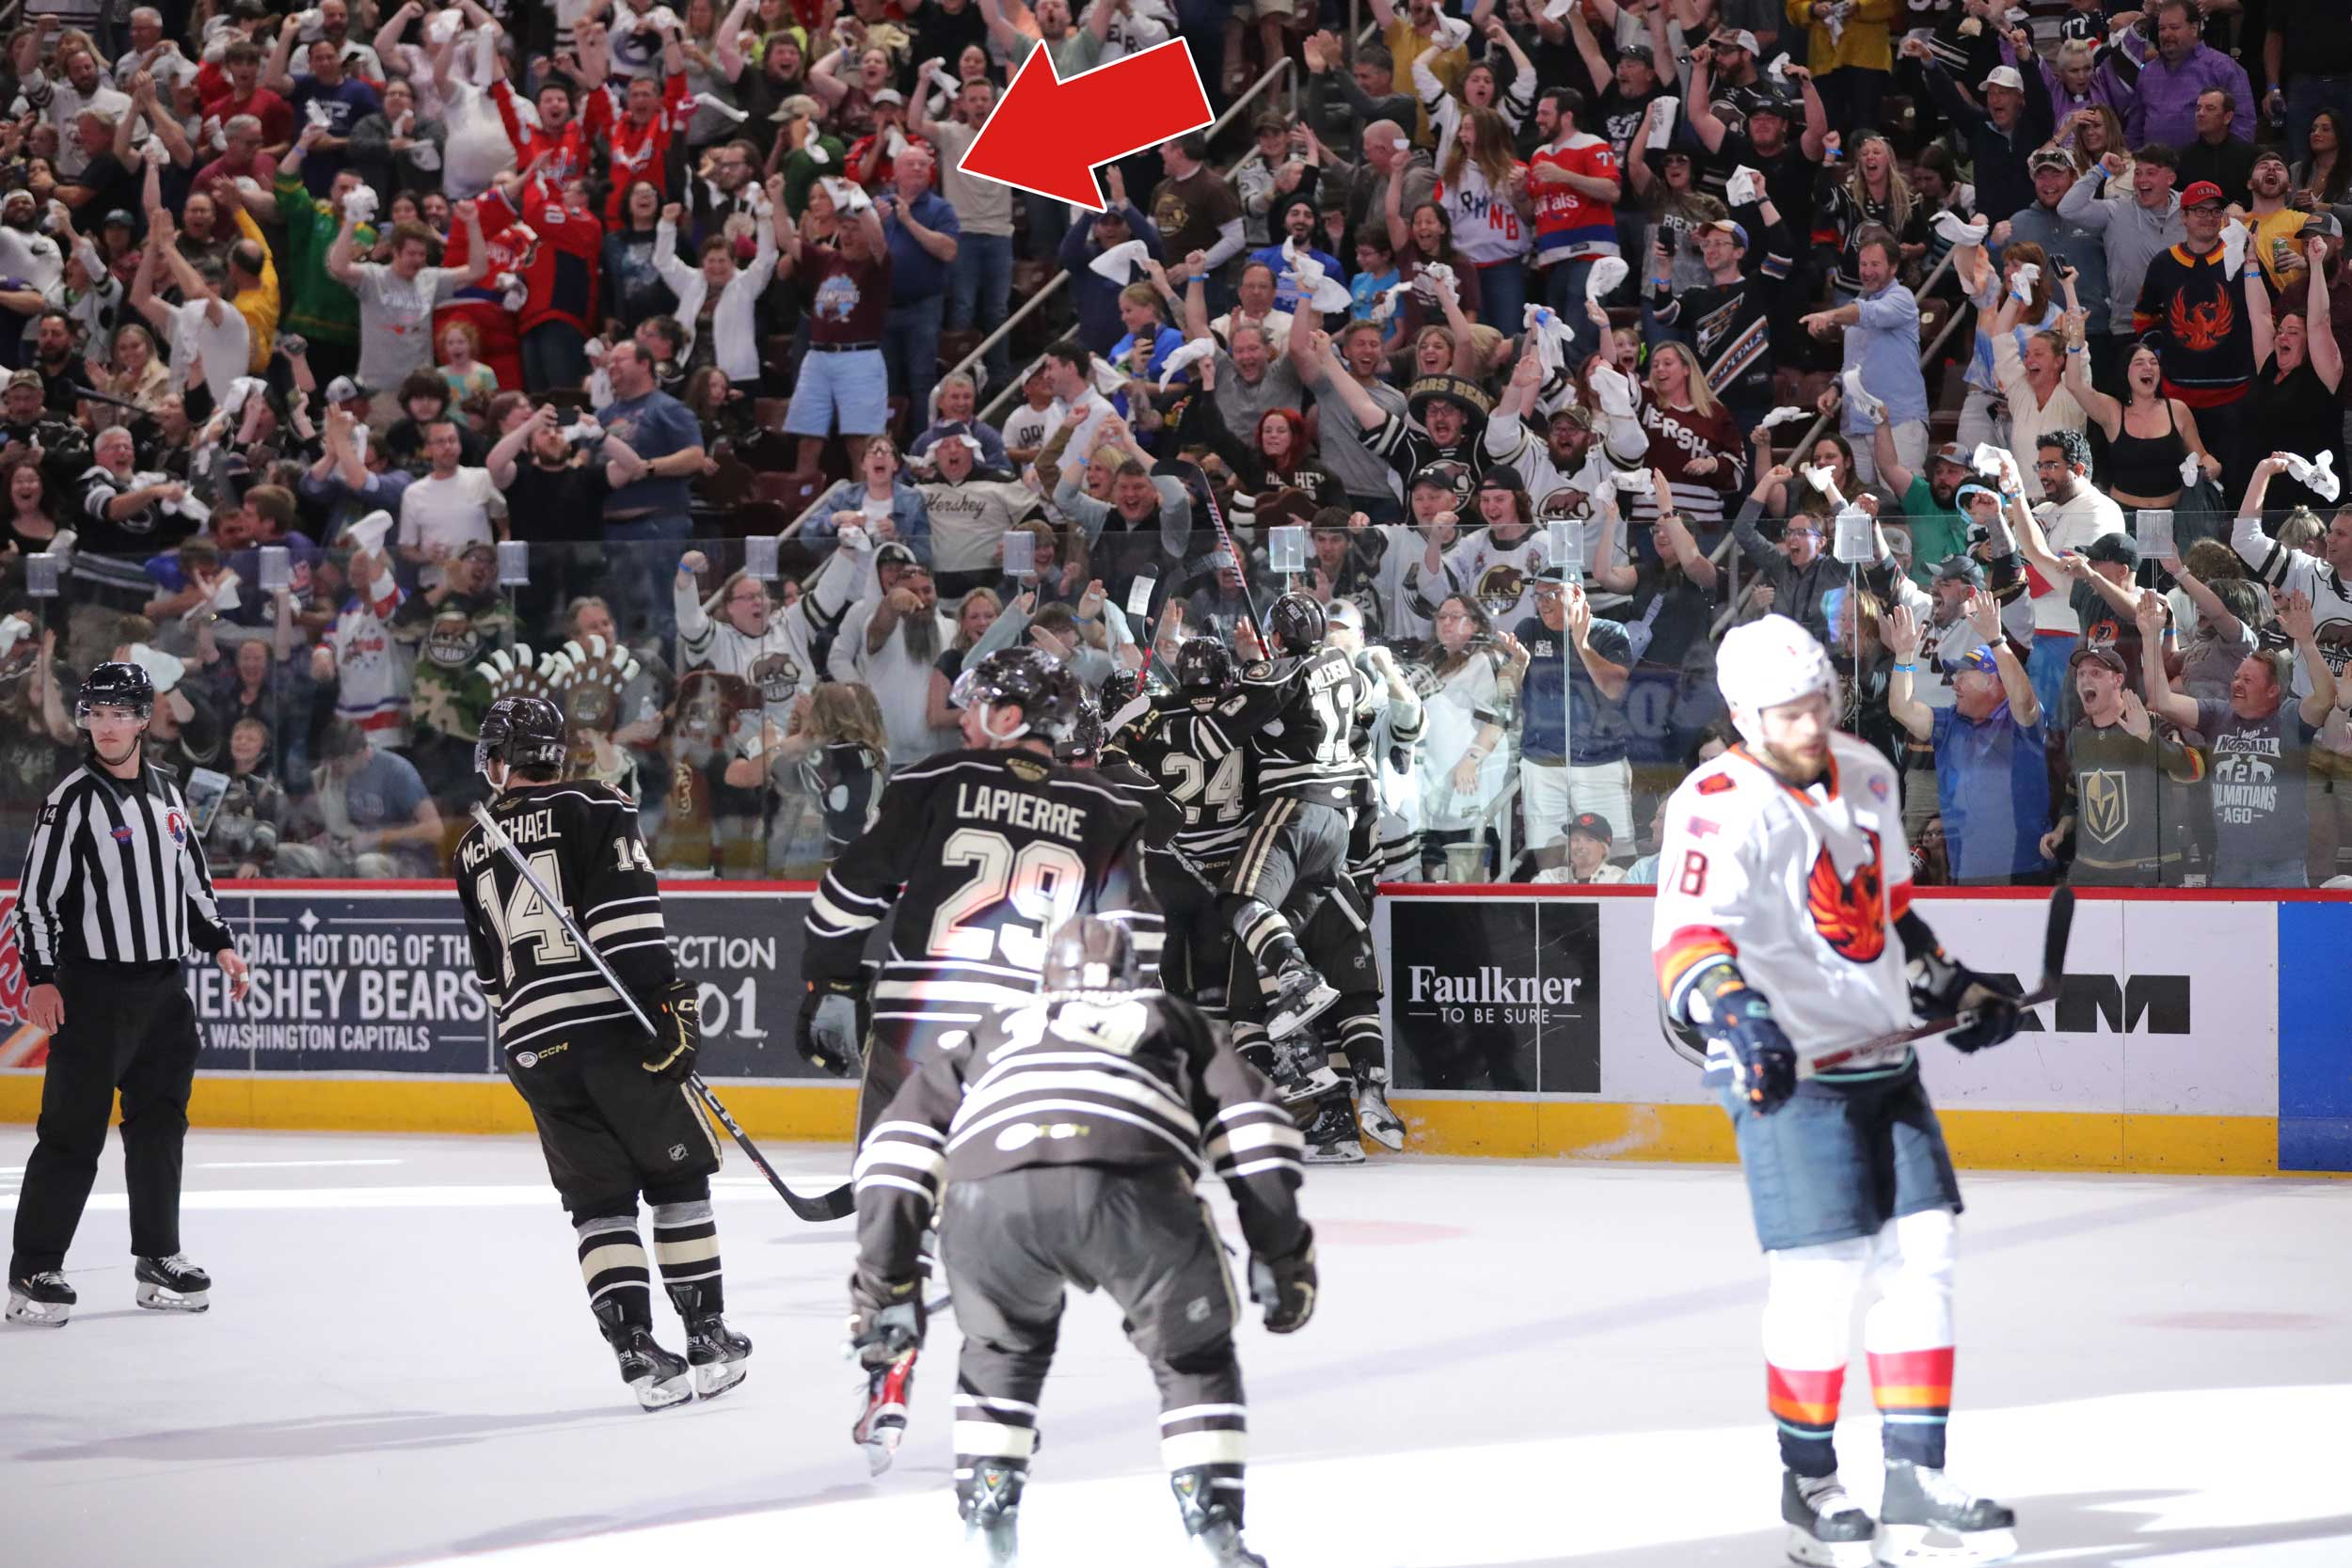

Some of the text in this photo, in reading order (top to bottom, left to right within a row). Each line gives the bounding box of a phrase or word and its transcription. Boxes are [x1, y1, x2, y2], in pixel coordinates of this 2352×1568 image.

[1265, 470, 1326, 490] HEHEY
[926, 492, 986, 520] Hershey
[1187, 657, 1203, 669] 24
[539, 744, 557, 761] 14
[1161, 746, 1245, 825] 24
[2234, 764, 2248, 783] 2
[956, 783, 1088, 843] LAPIERRE
[461, 808, 562, 874] McMCHAEL
[612, 836, 664, 875] 14
[476, 848, 581, 980] 14
[926, 827, 1087, 972] 29
[295, 933, 343, 966] HOT
[348, 933, 398, 966] DOG
[405, 934, 435, 966] OF
[438, 934, 475, 967] TH
[359, 969, 487, 1022] BEARS
[1407, 965, 1582, 1006] Faulkner
[1439, 1007, 1550, 1025] TO BE SURE
[209, 1023, 336, 1052] WASHINGTON
[340, 1024, 431, 1053] CAPITALS
[538, 1042, 569, 1060] CCM
[687, 1335, 701, 1347] 24
[618, 1349, 633, 1364] 24
